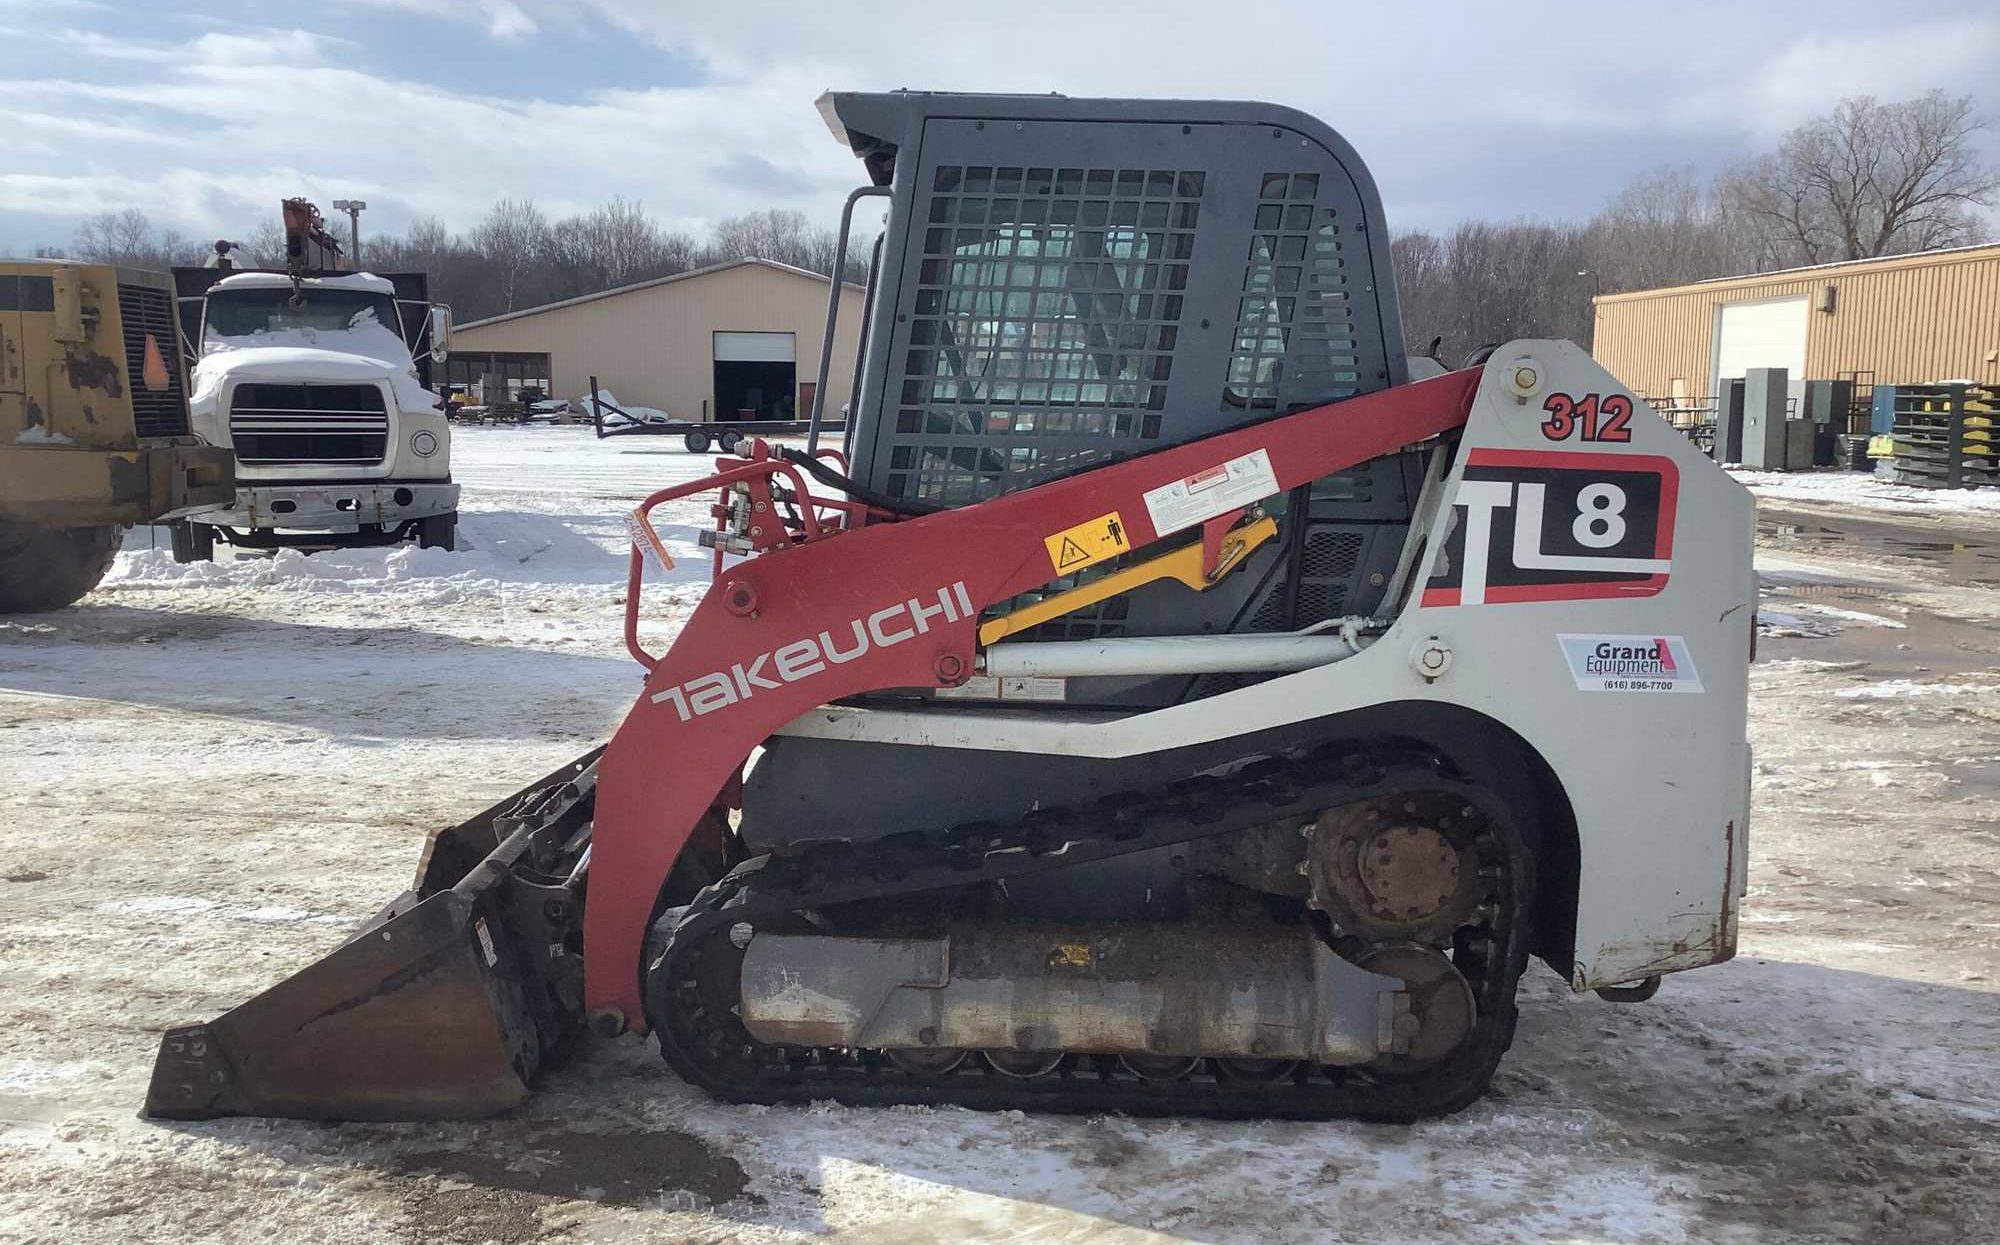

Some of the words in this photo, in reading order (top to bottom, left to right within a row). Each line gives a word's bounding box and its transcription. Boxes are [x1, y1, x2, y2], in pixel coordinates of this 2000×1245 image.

[1541, 392, 1633, 443] 312
[651, 581, 974, 721] TAKEUCHI
[1595, 643, 1662, 660] Grand
[1586, 655, 1664, 675] Equipment
[1604, 680, 1628, 690] (616)
[1630, 681, 1673, 690] 896-7700
